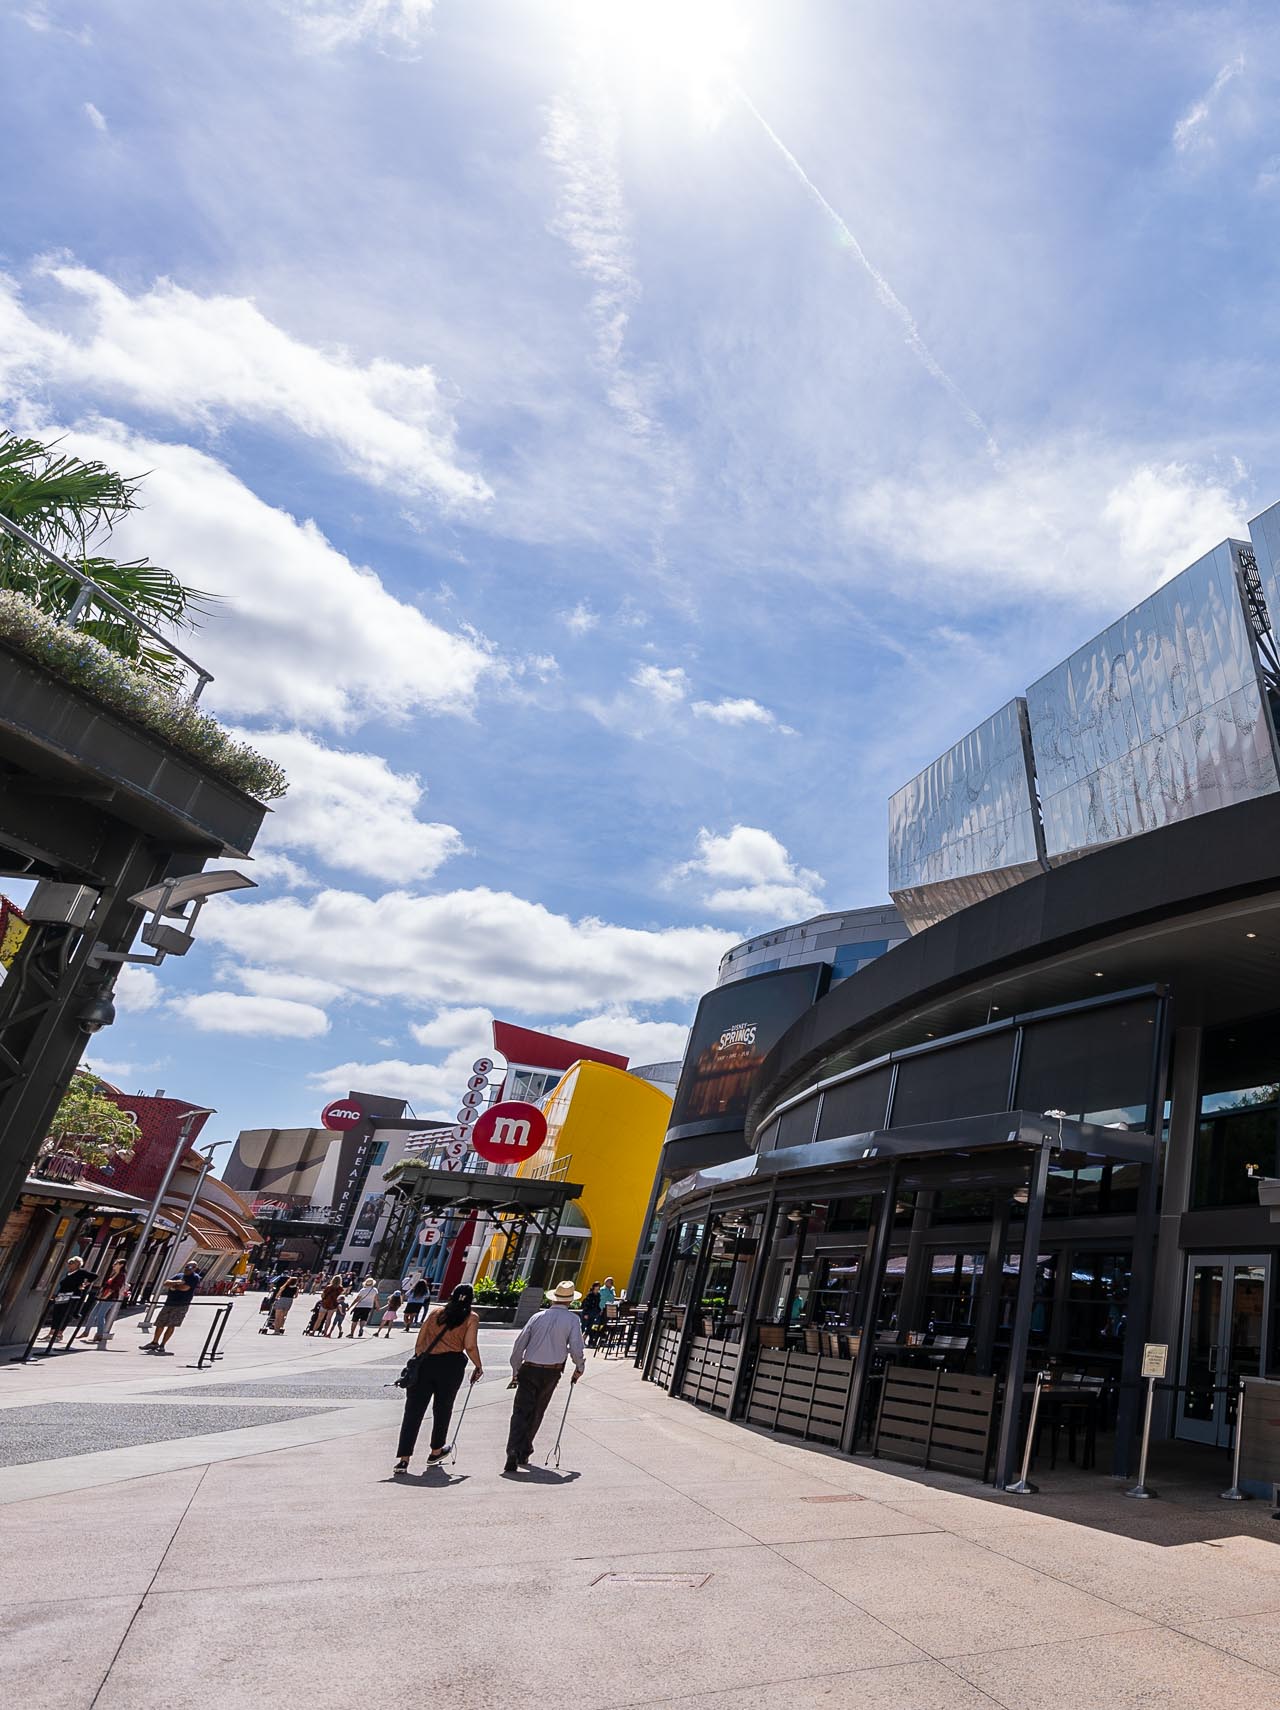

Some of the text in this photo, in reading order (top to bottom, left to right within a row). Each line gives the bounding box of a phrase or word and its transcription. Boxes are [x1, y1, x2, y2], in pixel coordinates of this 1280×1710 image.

[718, 1027, 757, 1050] SPRINGS
[490, 1117, 531, 1147] m
[335, 1135, 370, 1223] THEATRES
